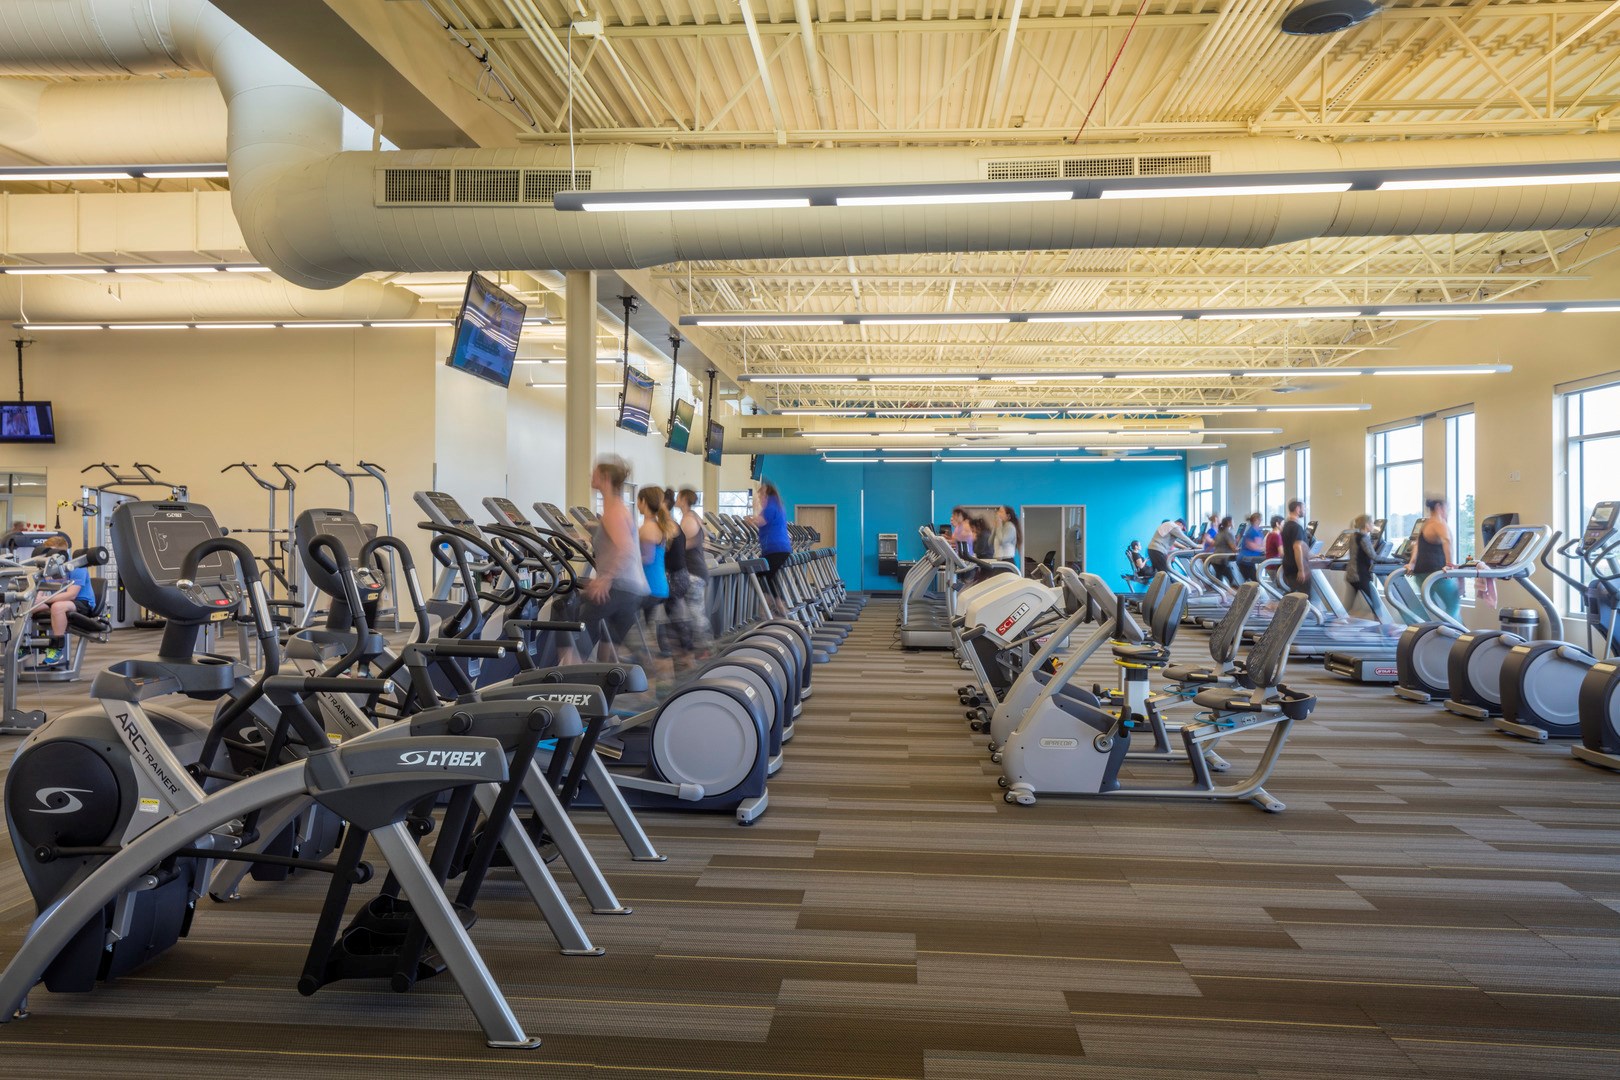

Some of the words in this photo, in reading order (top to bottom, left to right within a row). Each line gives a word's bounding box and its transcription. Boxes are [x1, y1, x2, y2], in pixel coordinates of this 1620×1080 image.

[999, 605, 1026, 634] SCIFIT
[328, 693, 357, 728] TRAINER
[116, 713, 147, 752] ARC
[142, 746, 178, 794] TRAINER
[426, 750, 486, 766] CYBEX
